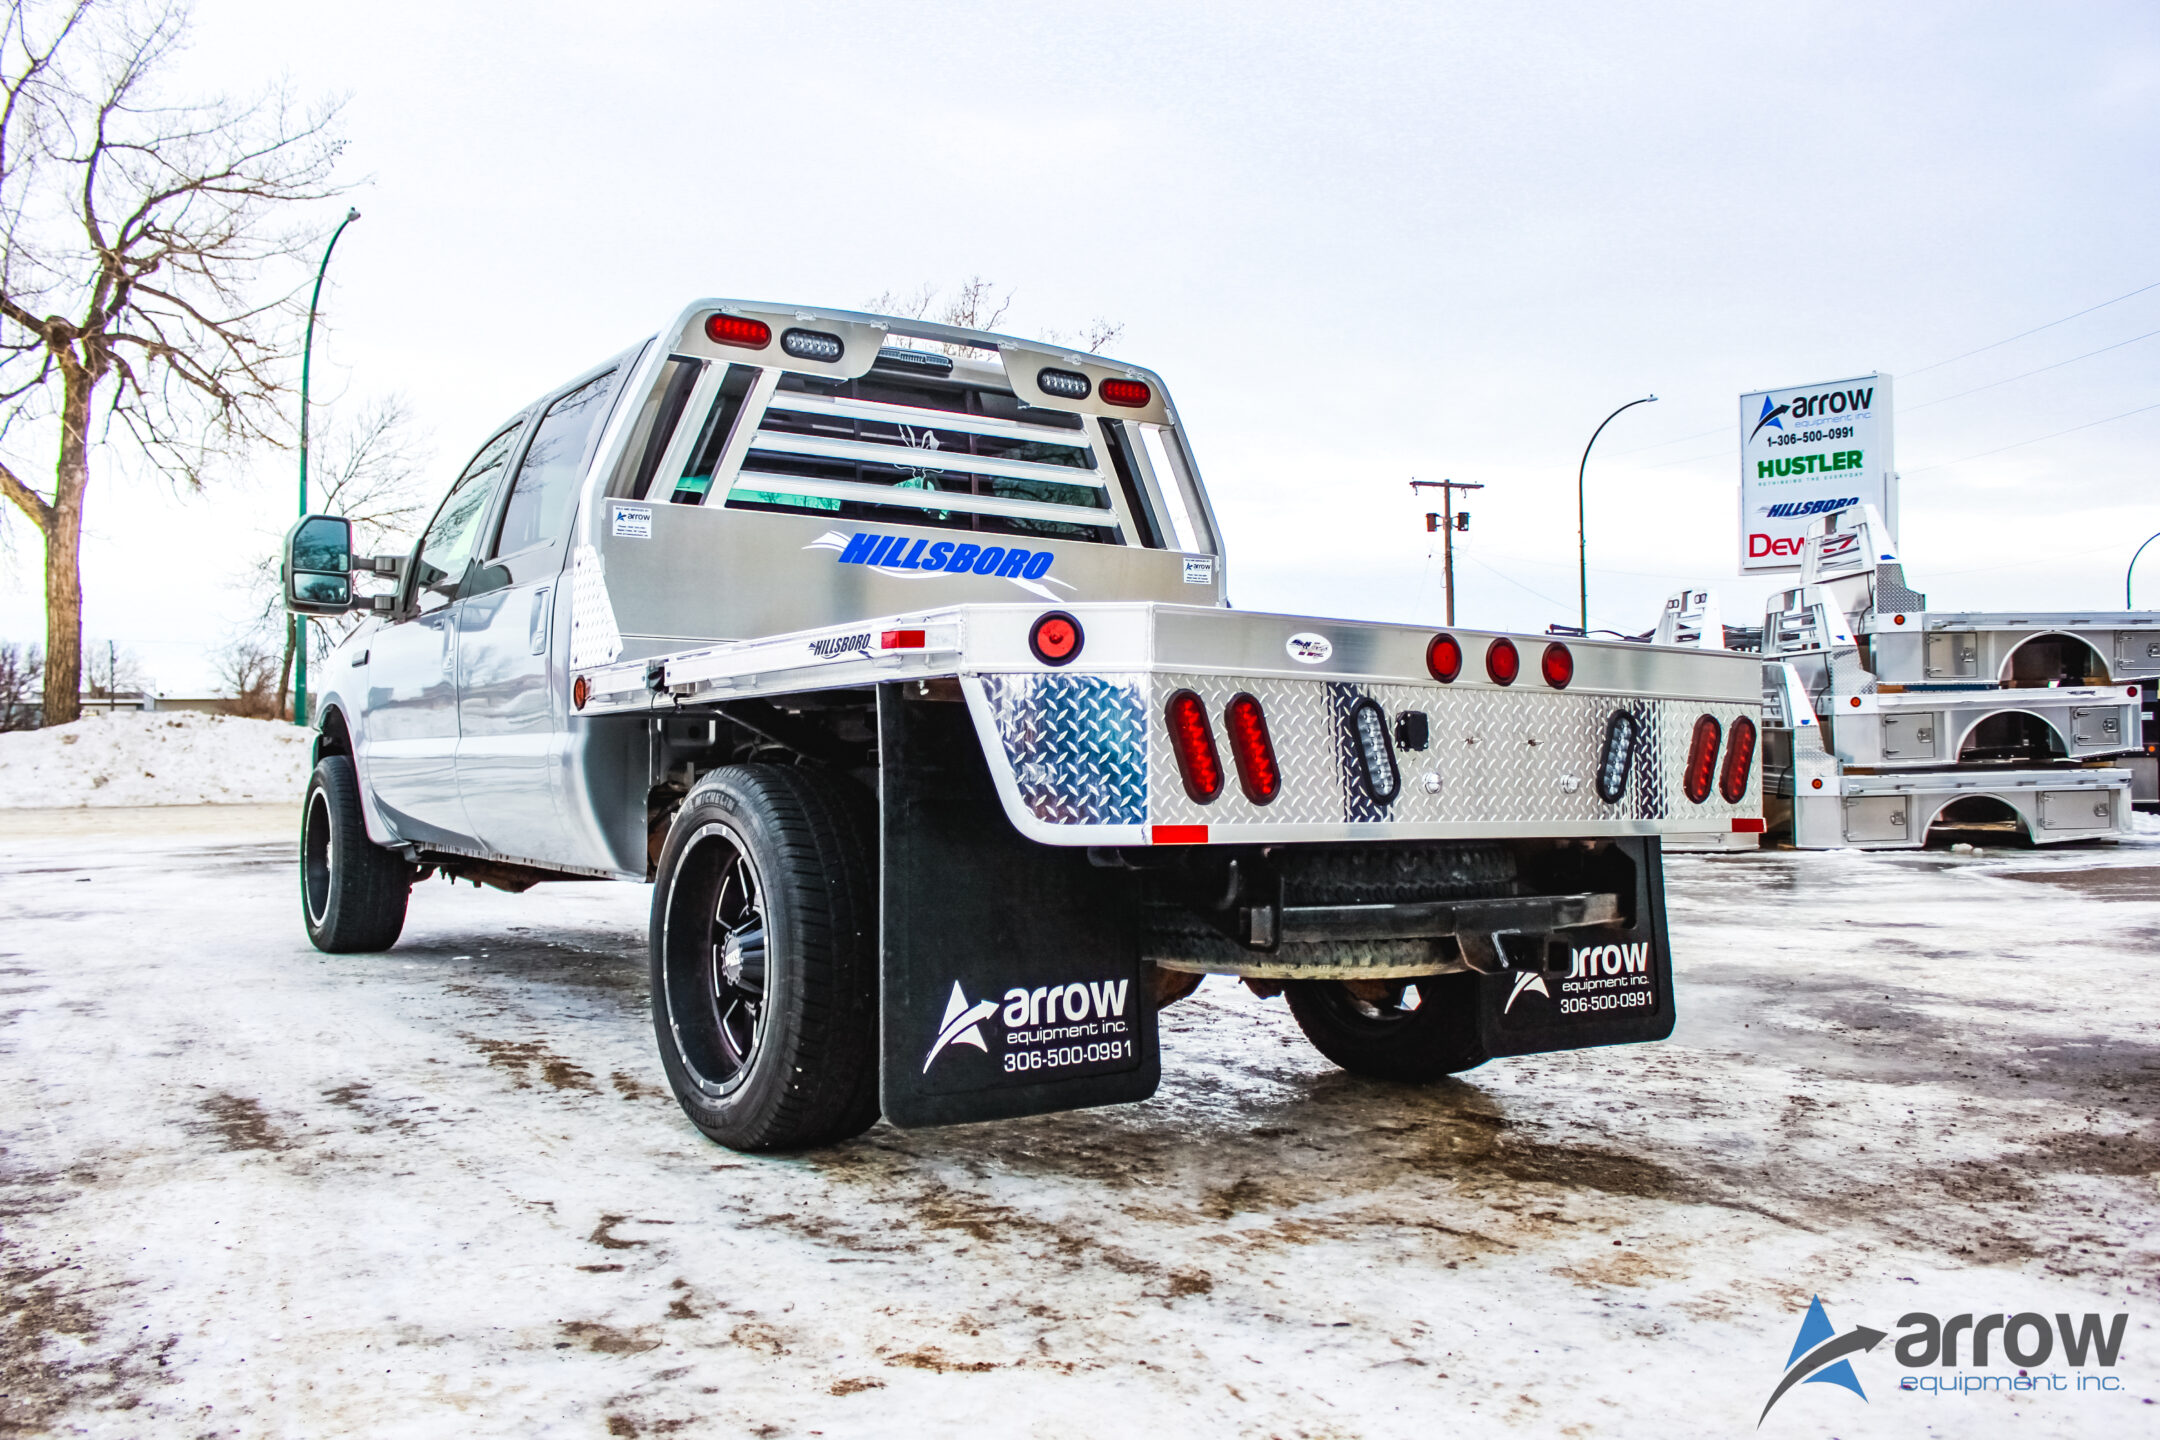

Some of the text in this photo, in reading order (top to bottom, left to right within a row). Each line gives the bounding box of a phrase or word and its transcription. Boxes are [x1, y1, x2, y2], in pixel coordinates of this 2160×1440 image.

[1792, 387, 1874, 418] arrow
[1794, 414, 1852, 428] equipment
[1767, 426, 1854, 447] 1-306-500-0991
[1757, 450, 1863, 479] HUSTLER
[1766, 496, 1860, 518] HILLSBORO
[838, 533, 1054, 580] HILLSBORO
[814, 633, 871, 656] HILLSBORO
[694, 791, 735, 811] MICHELIN
[1562, 974, 1650, 993] equipment inc.
[1003, 979, 1129, 1028] arrow
[1560, 991, 1653, 1014] 306-500-0991
[1006, 1020, 1129, 1046] equipment inc.
[1004, 1040, 1132, 1073] 306-500-0991
